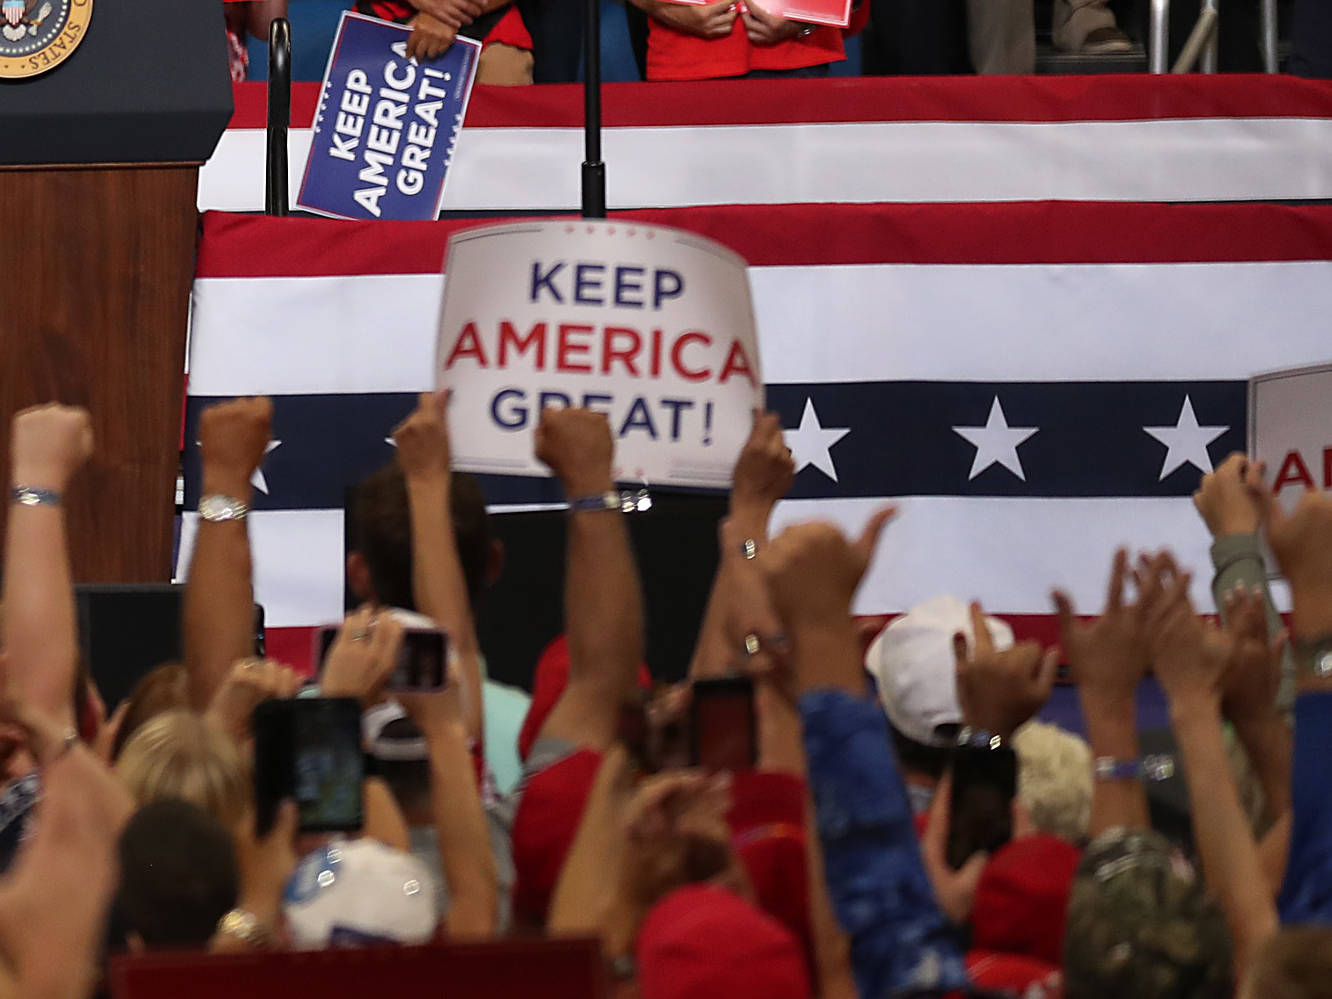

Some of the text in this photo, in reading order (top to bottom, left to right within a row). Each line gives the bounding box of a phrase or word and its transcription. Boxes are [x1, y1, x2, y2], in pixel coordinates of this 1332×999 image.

[28, 21, 82, 70] STATES
[328, 68, 373, 162] KEEP
[395, 67, 452, 196] GREAT!
[530, 261, 685, 311] KEEP
[444, 318, 759, 390] AMERICA
